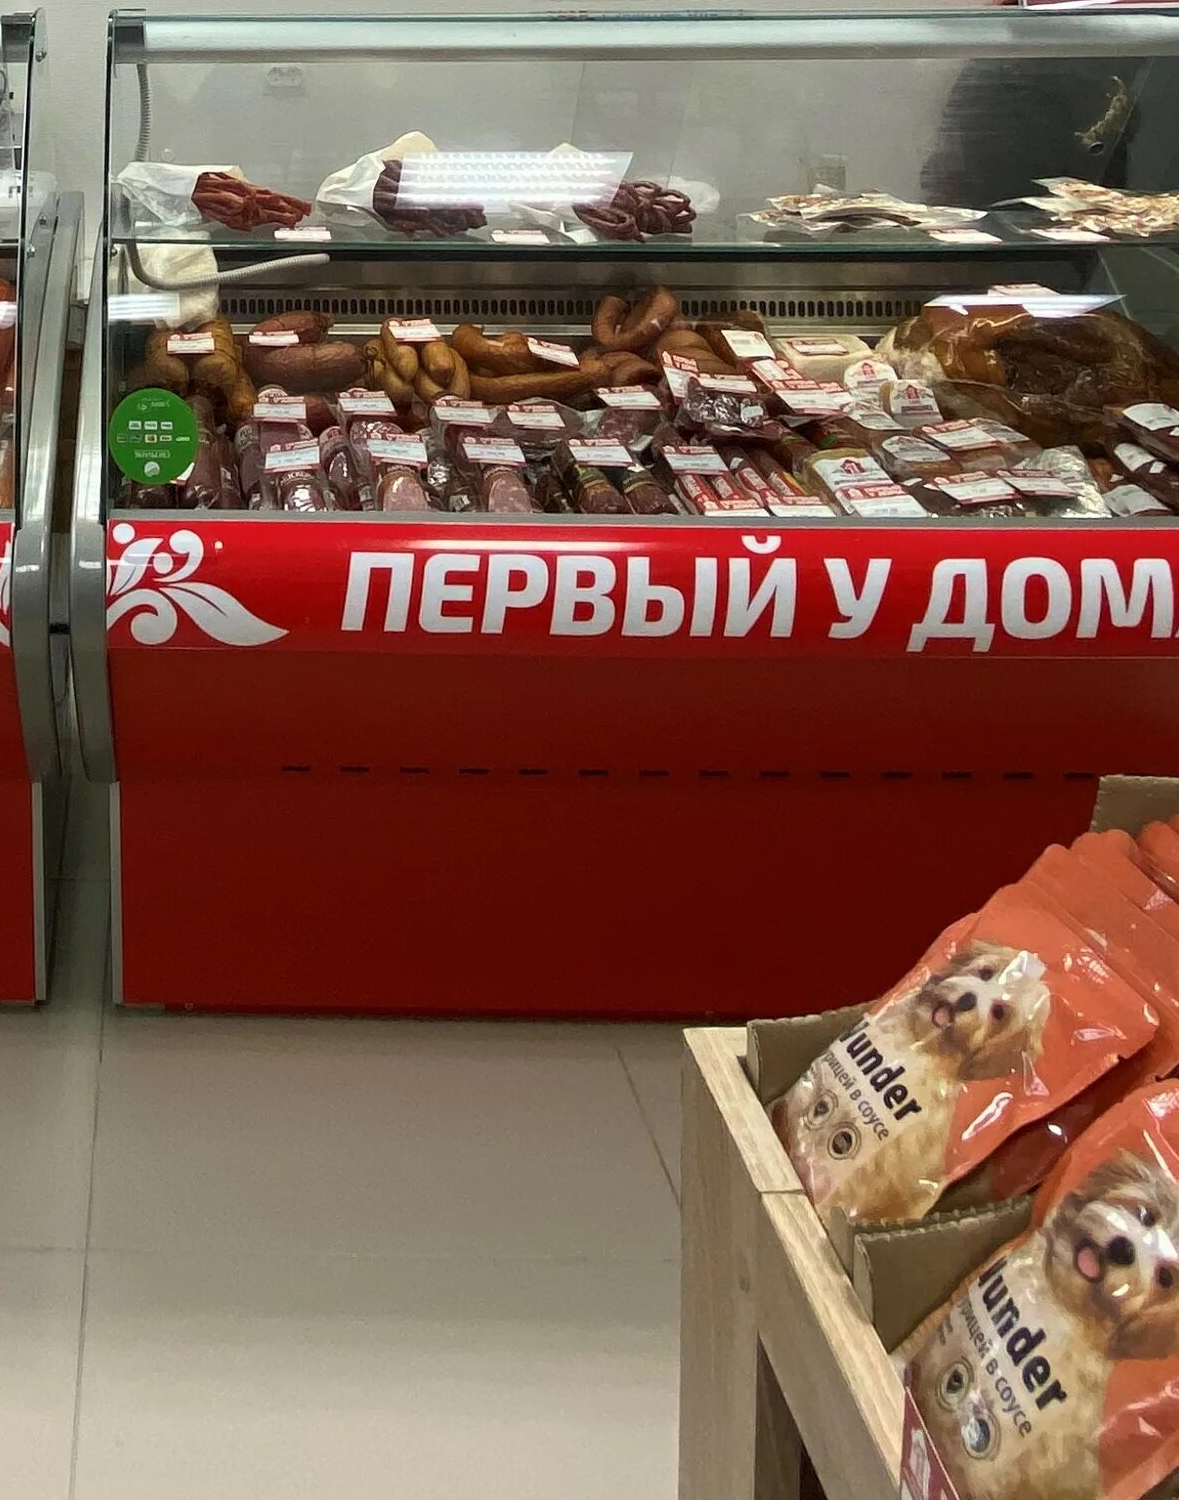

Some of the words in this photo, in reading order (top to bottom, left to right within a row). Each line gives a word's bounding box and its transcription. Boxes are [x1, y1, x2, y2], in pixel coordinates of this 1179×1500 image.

[340, 535, 798, 638] ПЕРВЫЙ
[823, 557, 893, 639] У
[906, 557, 1179, 653] ДОМ
[823, 1051, 857, 1091] рицей
[857, 1100, 890, 1141] соусе
[994, 1376, 1033, 1438] соусе
